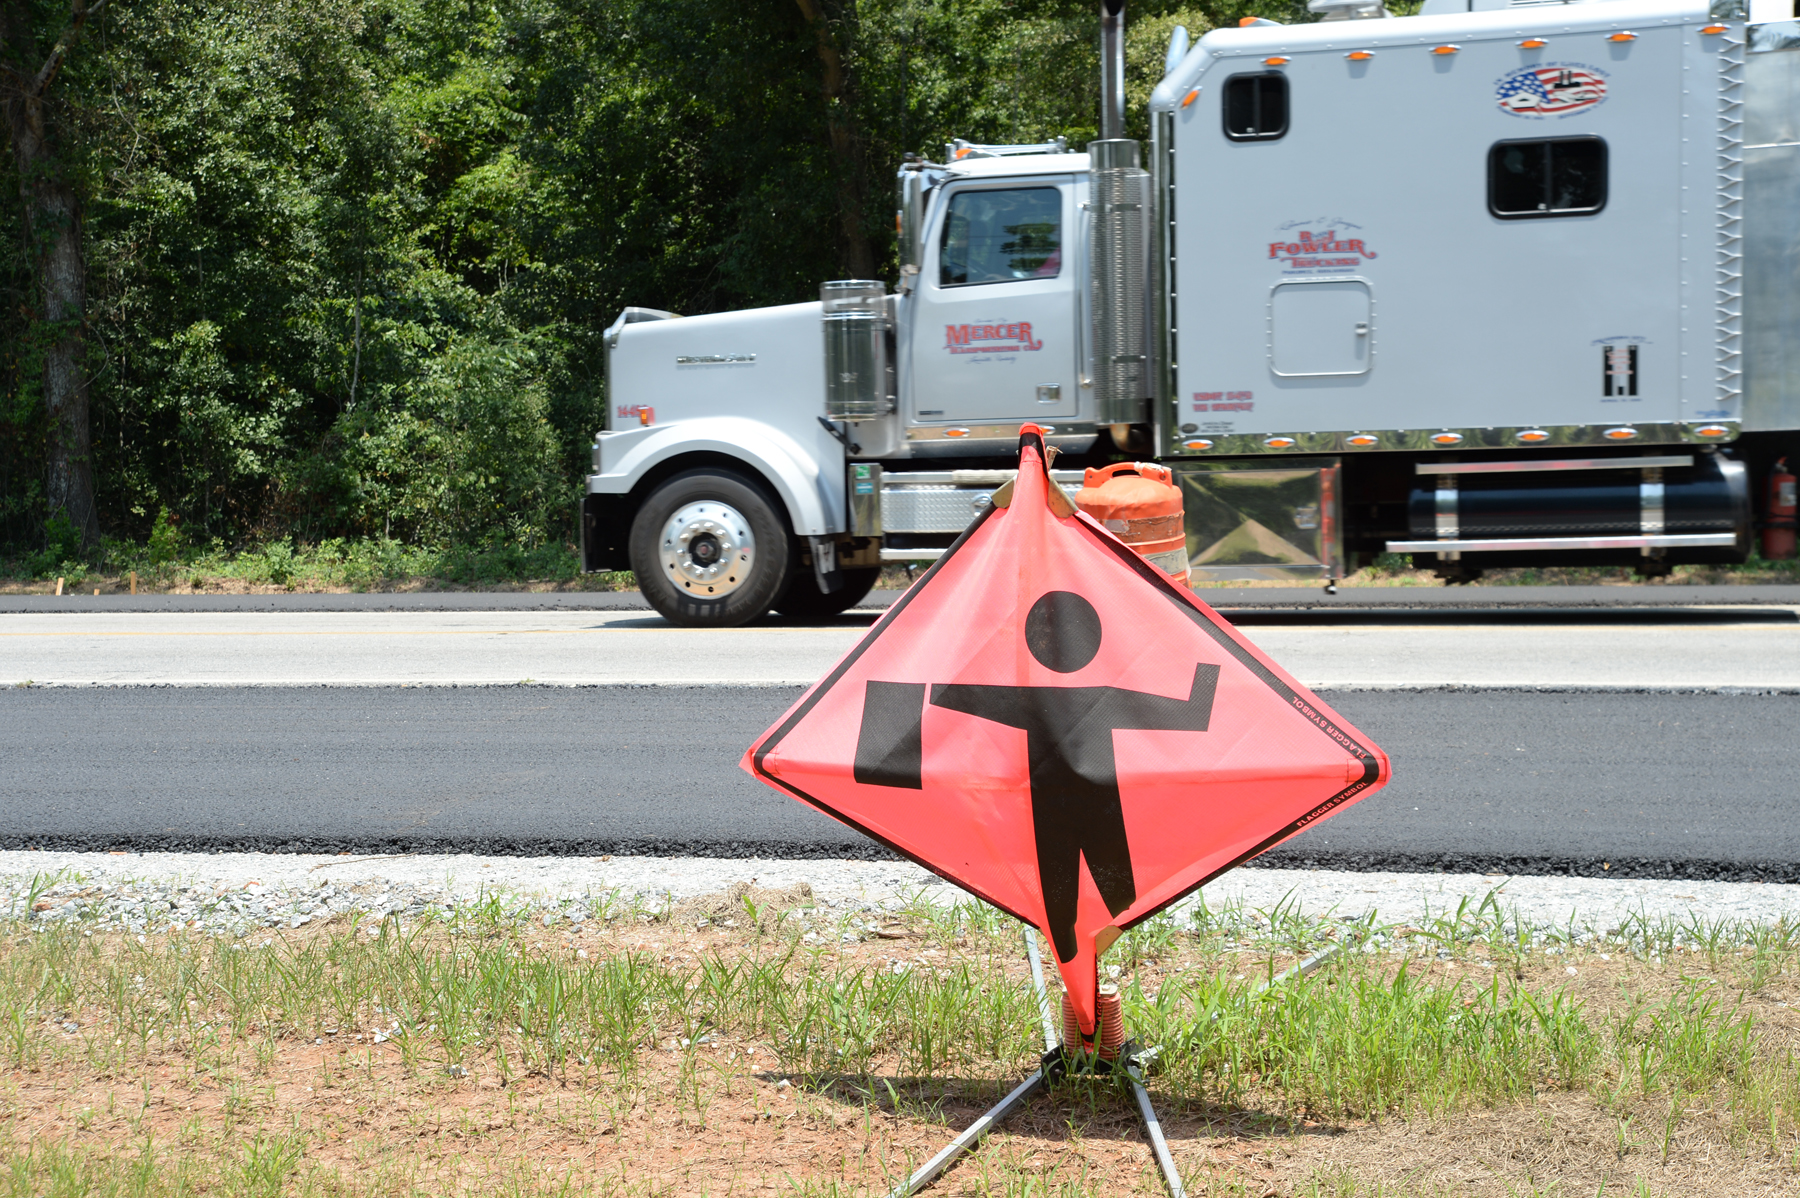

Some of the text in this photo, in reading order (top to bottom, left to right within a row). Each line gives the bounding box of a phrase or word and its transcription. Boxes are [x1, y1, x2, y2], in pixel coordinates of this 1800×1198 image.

[1268, 239, 1378, 259] FOWLER
[1280, 256, 1360, 268] TRUCKING
[945, 321, 1043, 351] MERCER
[1292, 696, 1367, 760] FLAGGER SYMBOL
[1296, 782, 1368, 827] FLAGGER SYMBOL
